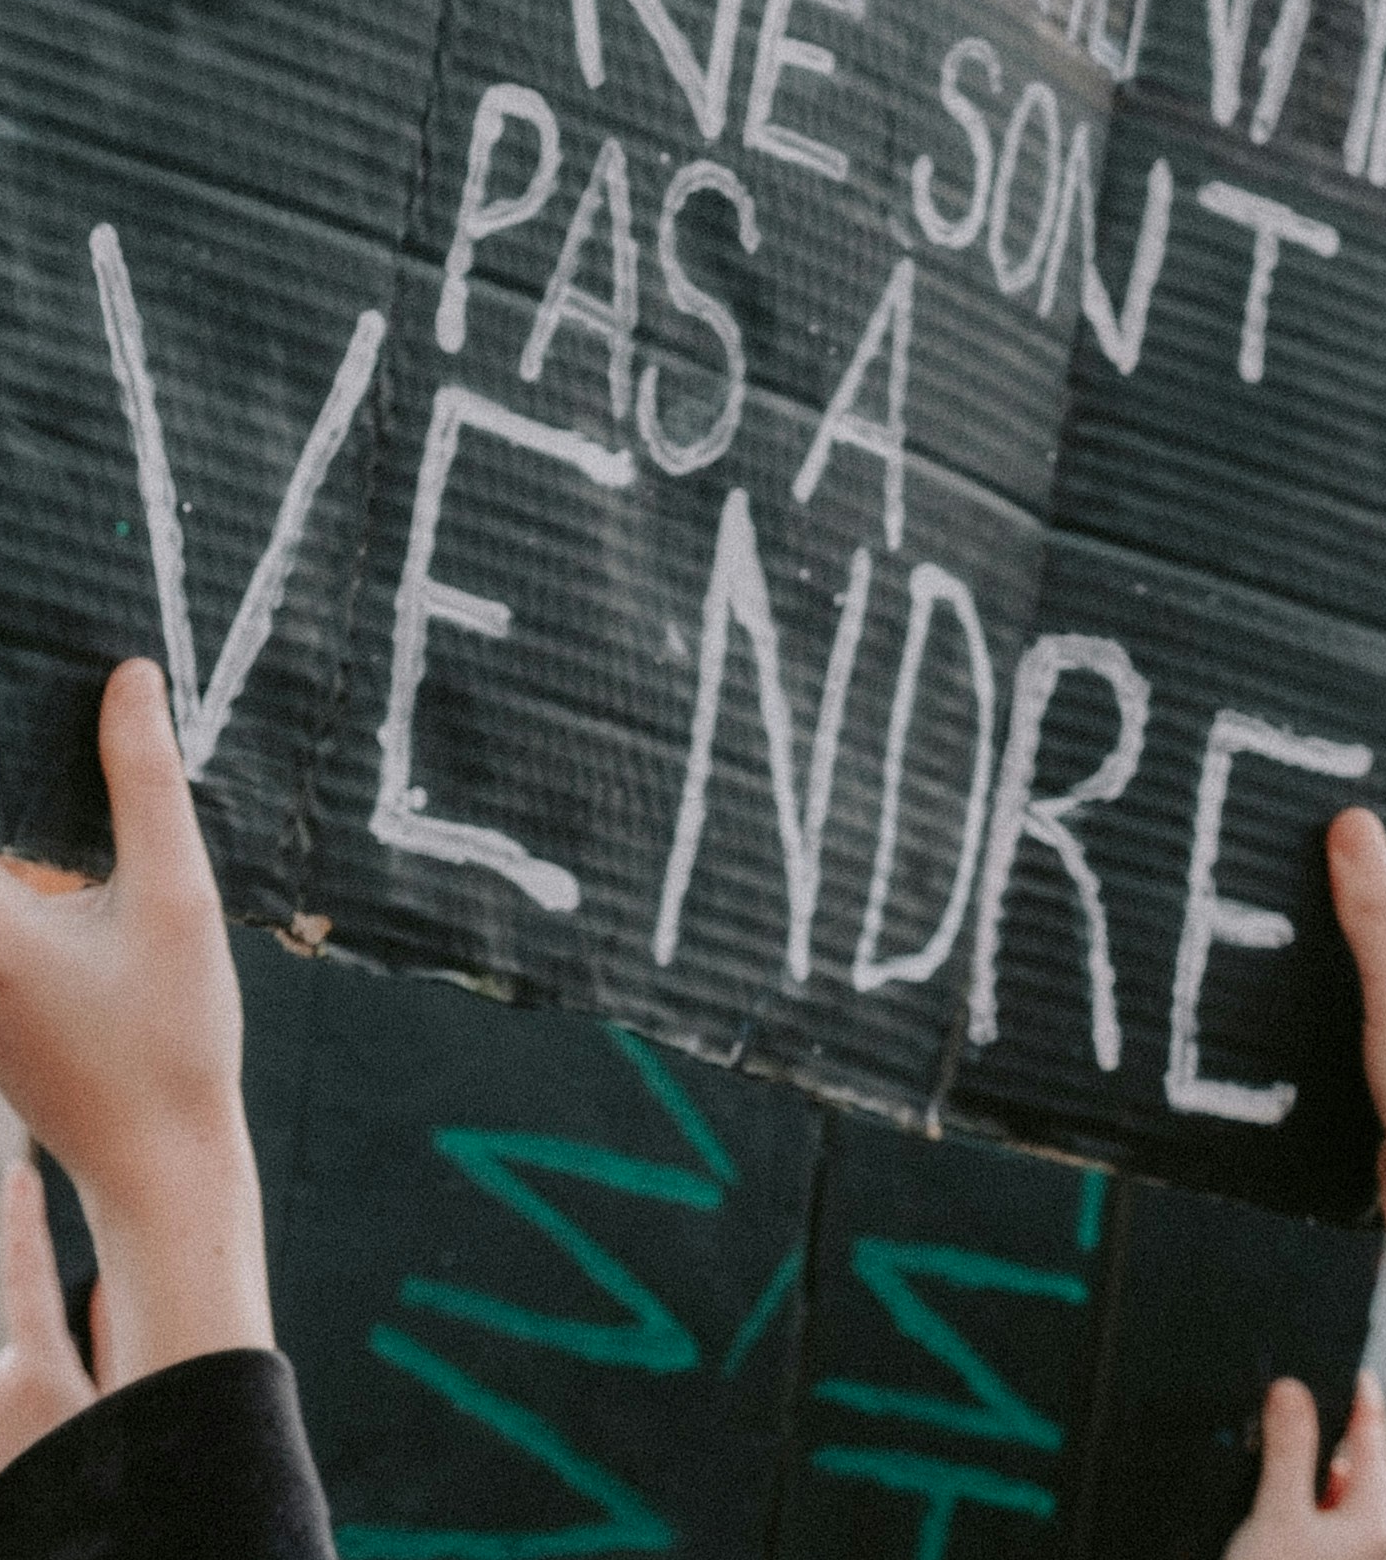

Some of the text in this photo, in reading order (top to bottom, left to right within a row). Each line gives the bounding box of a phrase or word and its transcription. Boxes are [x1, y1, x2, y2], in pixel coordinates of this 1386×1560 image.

[435, 82, 915, 551] PAS A
[911, 36, 1342, 384] SONT
[89, 222, 1373, 1125] VENDRE
